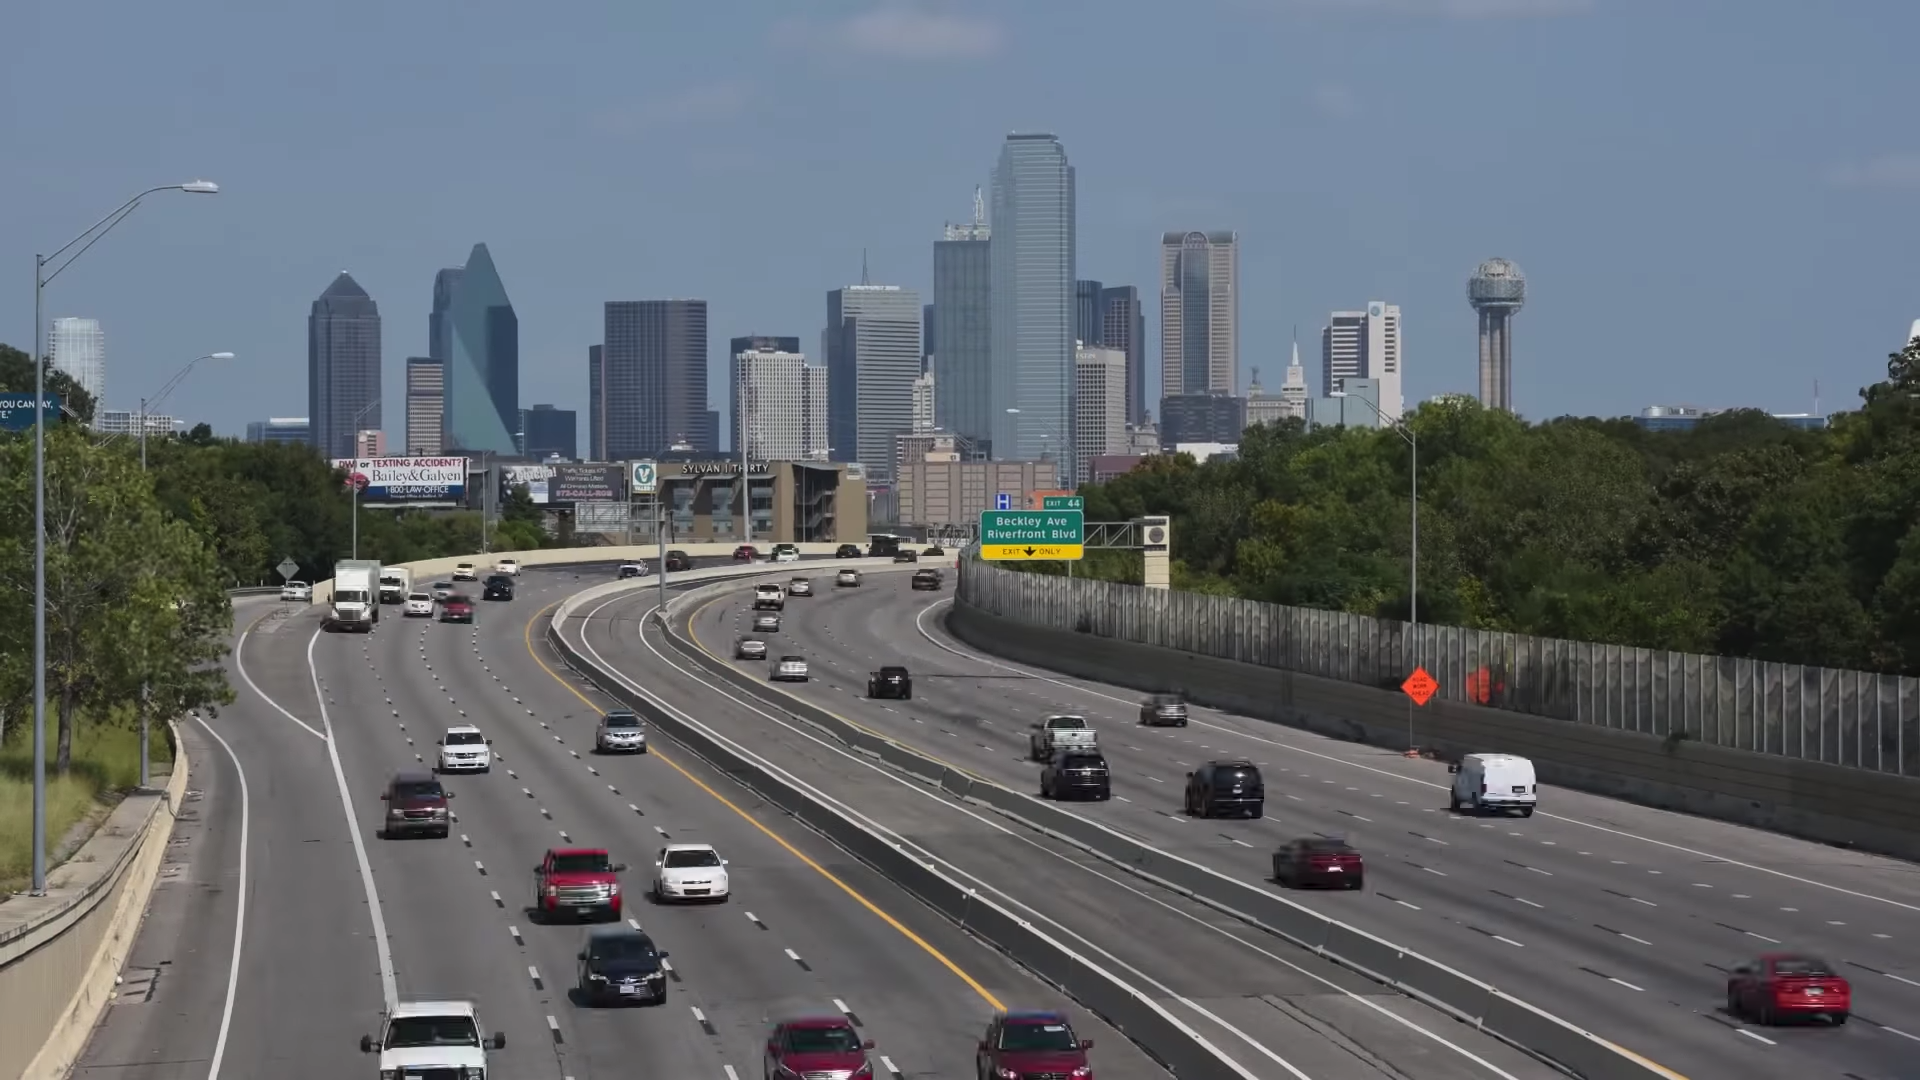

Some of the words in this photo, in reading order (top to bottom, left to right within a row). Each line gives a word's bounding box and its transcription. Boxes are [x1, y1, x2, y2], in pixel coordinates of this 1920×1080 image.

[17, 400, 35, 408] CAN
[42, 400, 53, 410] AY,
[0, 410, 12, 419] E."
[373, 459, 411, 468] TEXTING
[414, 458, 462, 467] ACCIDENT?
[682, 464, 720, 473] SYLVAN
[385, 485, 449, 494] 1-800-LAW-OFFICE
[997, 495, 1009, 509] H
[997, 517, 1041, 527] Beckley
[1047, 517, 1067, 526] Ave
[988, 530, 1046, 538] Riverfront
[1052, 530, 1076, 538] Blvd
